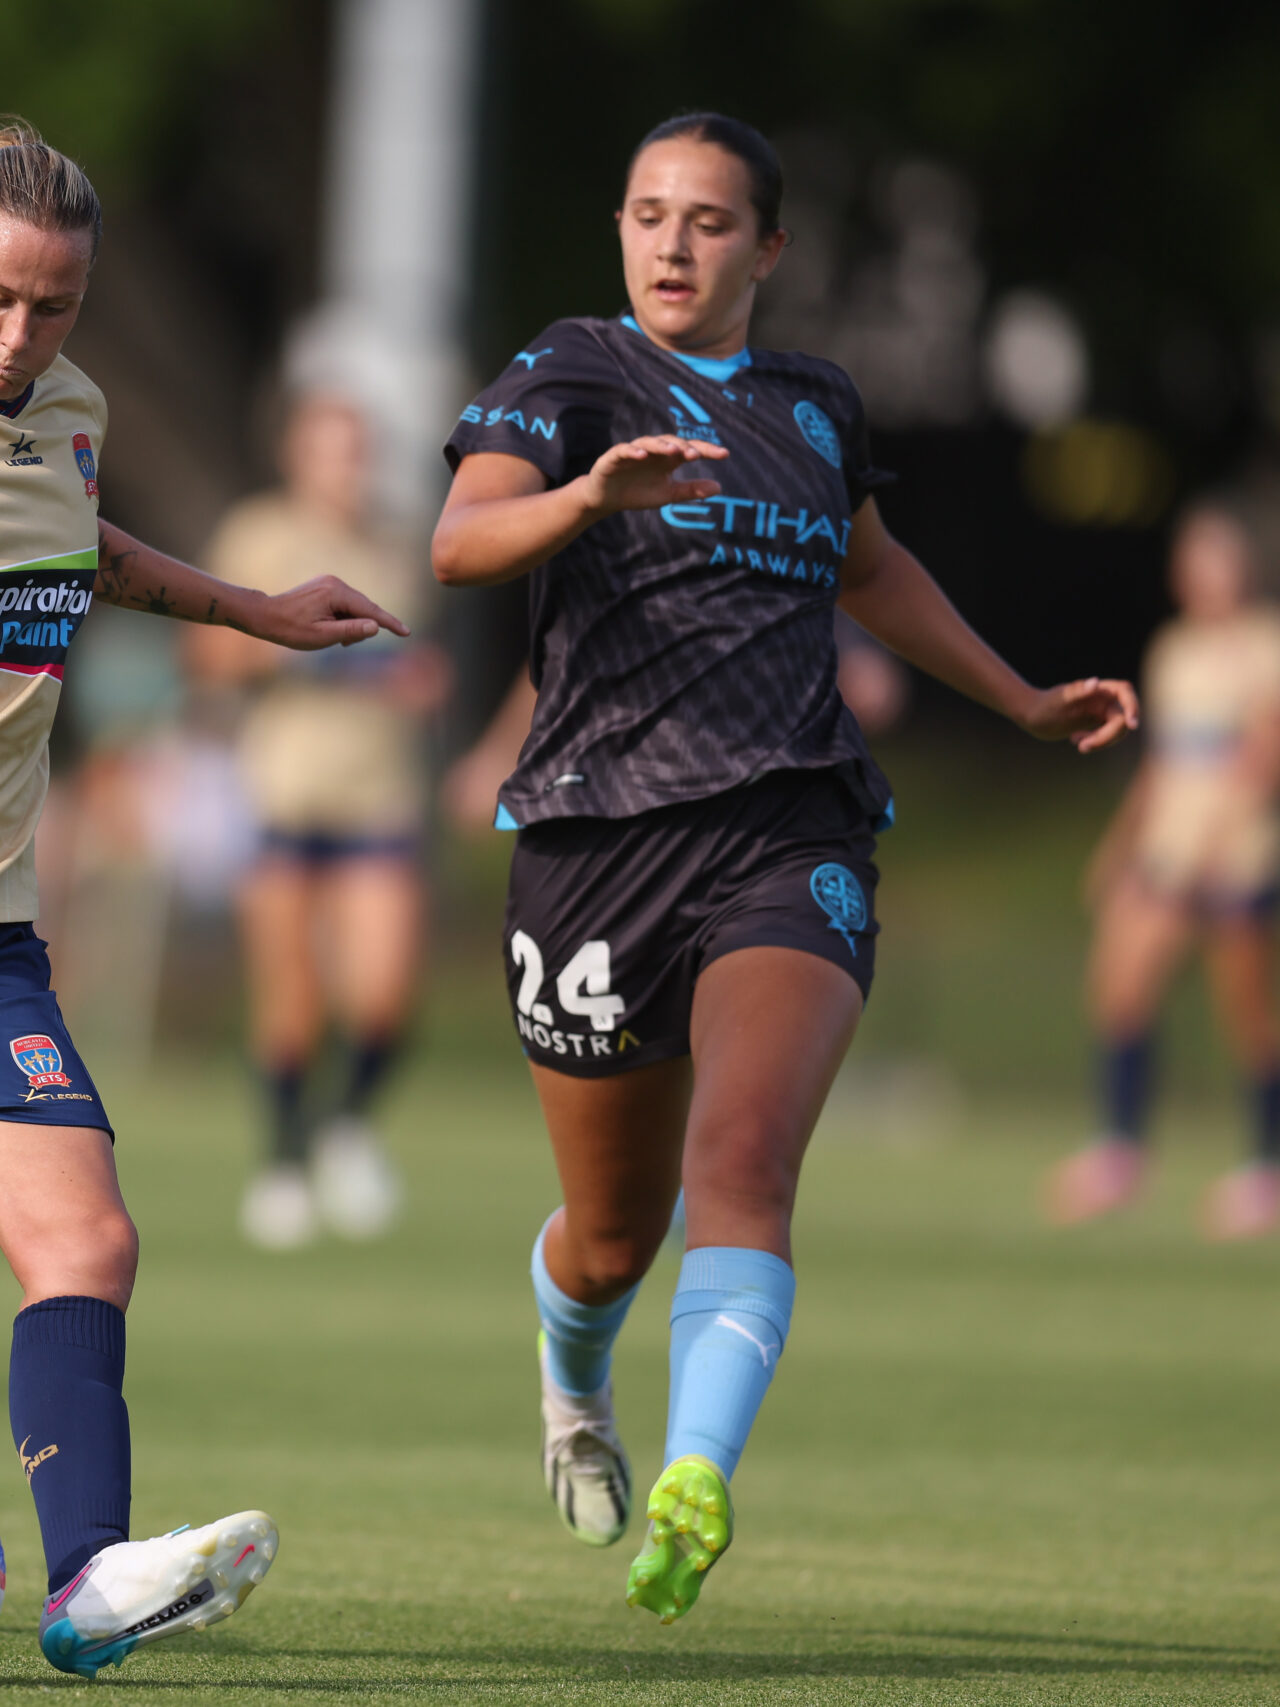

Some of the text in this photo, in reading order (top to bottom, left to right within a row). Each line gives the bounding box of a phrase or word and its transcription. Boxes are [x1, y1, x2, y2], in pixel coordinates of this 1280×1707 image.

[4, 456, 43, 466] LEGEND
[709, 544, 836, 588] AIRWAYS
[511, 929, 625, 1031] 24
[518, 1013, 640, 1057] NOSTRA
[36, 1074, 63, 1084] JETS
[51, 1093, 93, 1102] LEGEND
